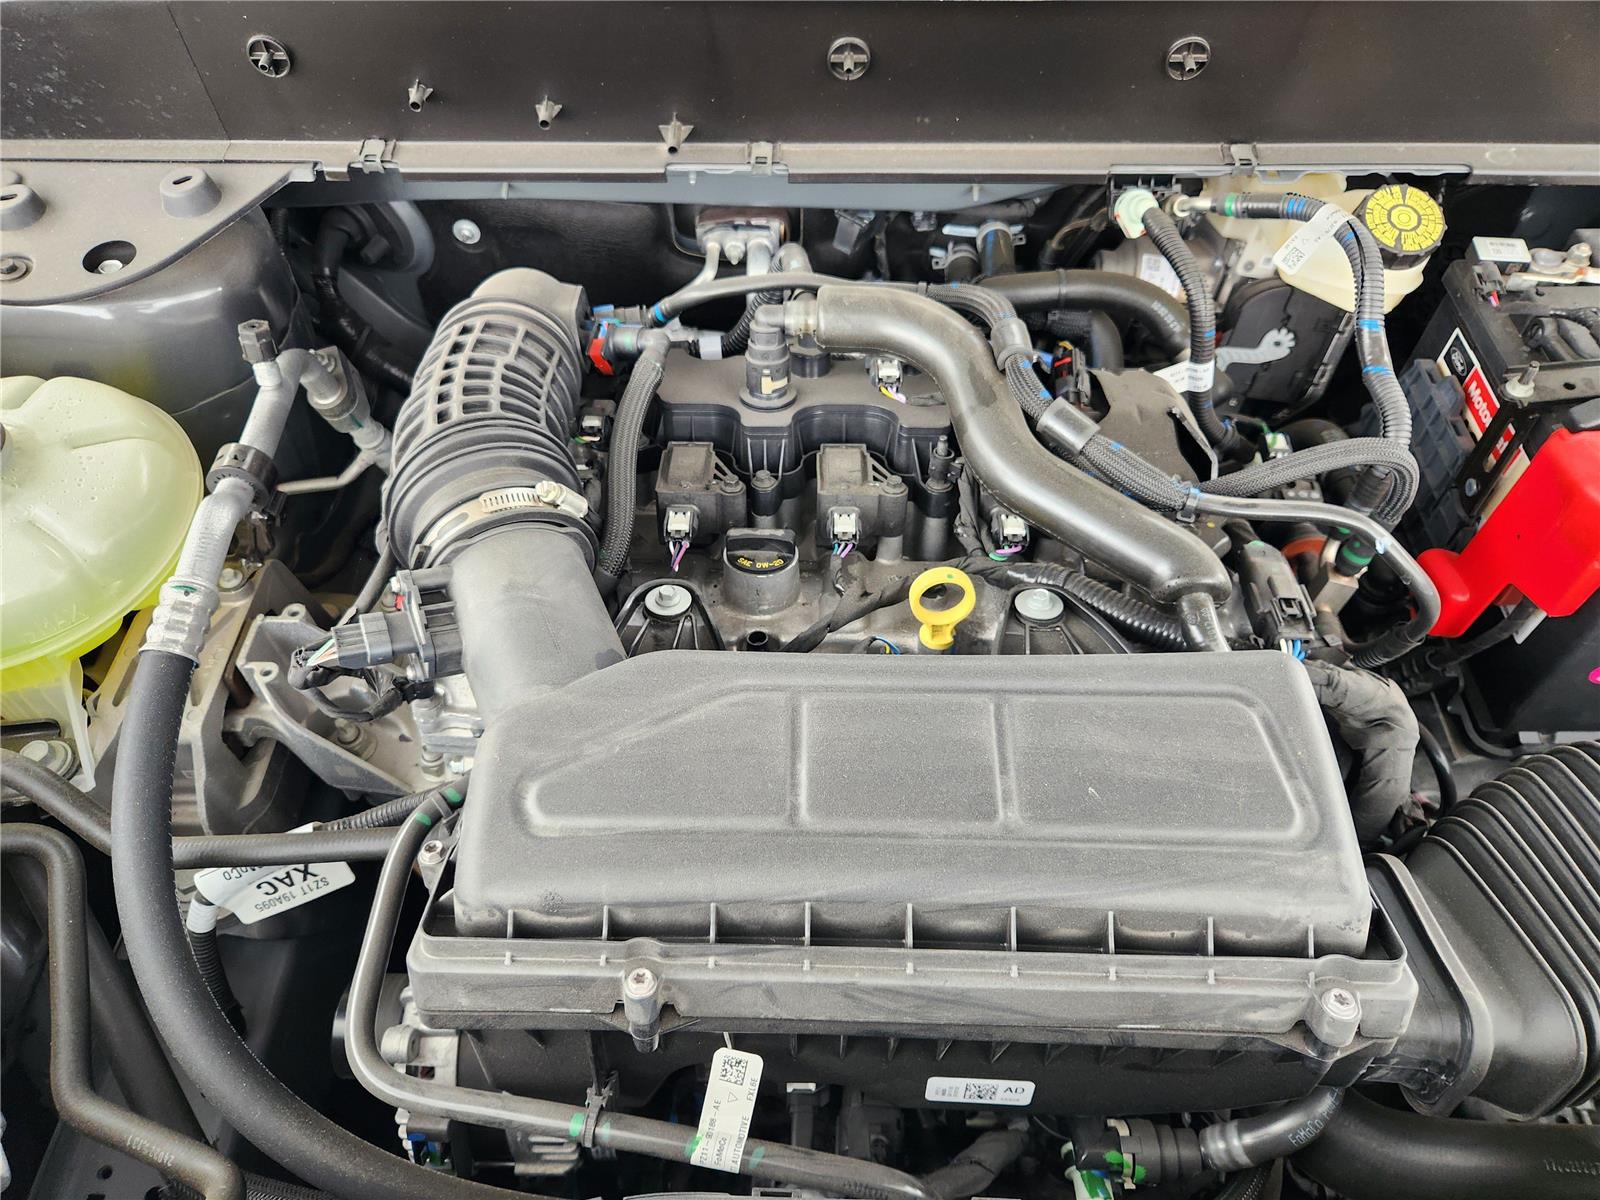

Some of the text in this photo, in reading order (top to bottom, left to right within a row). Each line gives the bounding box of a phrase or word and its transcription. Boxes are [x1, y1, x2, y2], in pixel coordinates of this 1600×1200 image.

[737, 557, 753, 567] SAE
[256, 863, 319, 896] XAC
[255, 890, 297, 912] 19A095
[1004, 1086, 1025, 1095] AD
[714, 1137, 727, 1167] FoMoCo
[731, 1115, 750, 1164] AUTOMOTIVE
